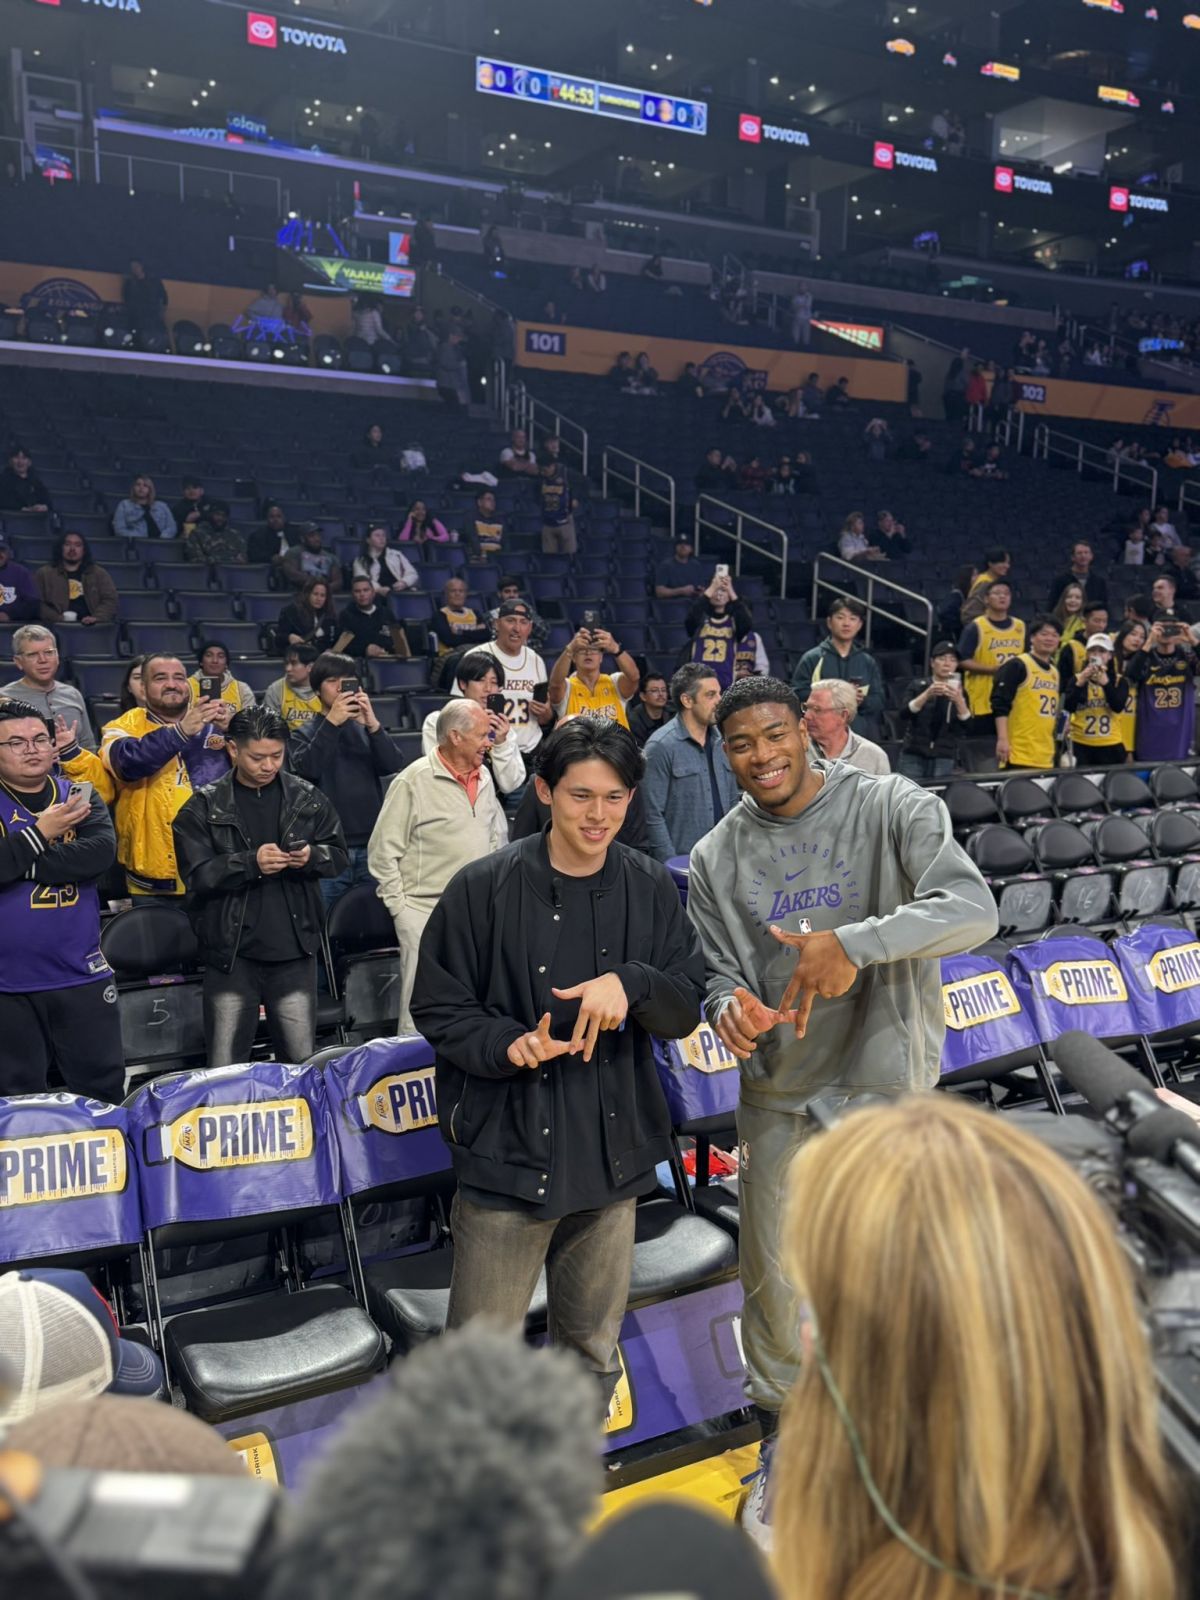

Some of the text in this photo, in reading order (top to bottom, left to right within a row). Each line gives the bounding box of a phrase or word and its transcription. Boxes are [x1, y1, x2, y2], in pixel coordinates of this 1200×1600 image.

[280, 26, 347, 54] TOYOTA
[495, 70, 506, 88] 0
[530, 77, 541, 95] 0
[560, 83, 594, 106] 44:53
[645, 100, 656, 117] 0
[677, 107, 687, 123] 0
[762, 124, 810, 147] TOYOTA
[895, 151, 938, 172] TOYOTA
[1013, 175, 1053, 195] TOYOTA
[1129, 194, 1168, 212] TOYOTA
[530, 333, 559, 352] 101
[703, 639, 727, 662] 23
[1040, 695, 1057, 717] 28
[1155, 688, 1182, 708] 23
[287, 707, 316, 720] LAKE
[504, 699, 530, 723] 23
[580, 704, 617, 719] LAKERS
[1084, 714, 1111, 737] 28
[770, 842, 830, 864] LAKERS
[766, 883, 843, 921] LAKERS
[378, 973, 399, 997] 7
[1060, 966, 1119, 999] PRIME
[147, 998, 170, 1026] 5
[948, 978, 1010, 1023] PRIME
[388, 1077, 437, 1125] PRI
[199, 1108, 296, 1162] PRIME
[0, 1139, 108, 1198] PRIME
[252, 1447, 262, 1475] DRINK
